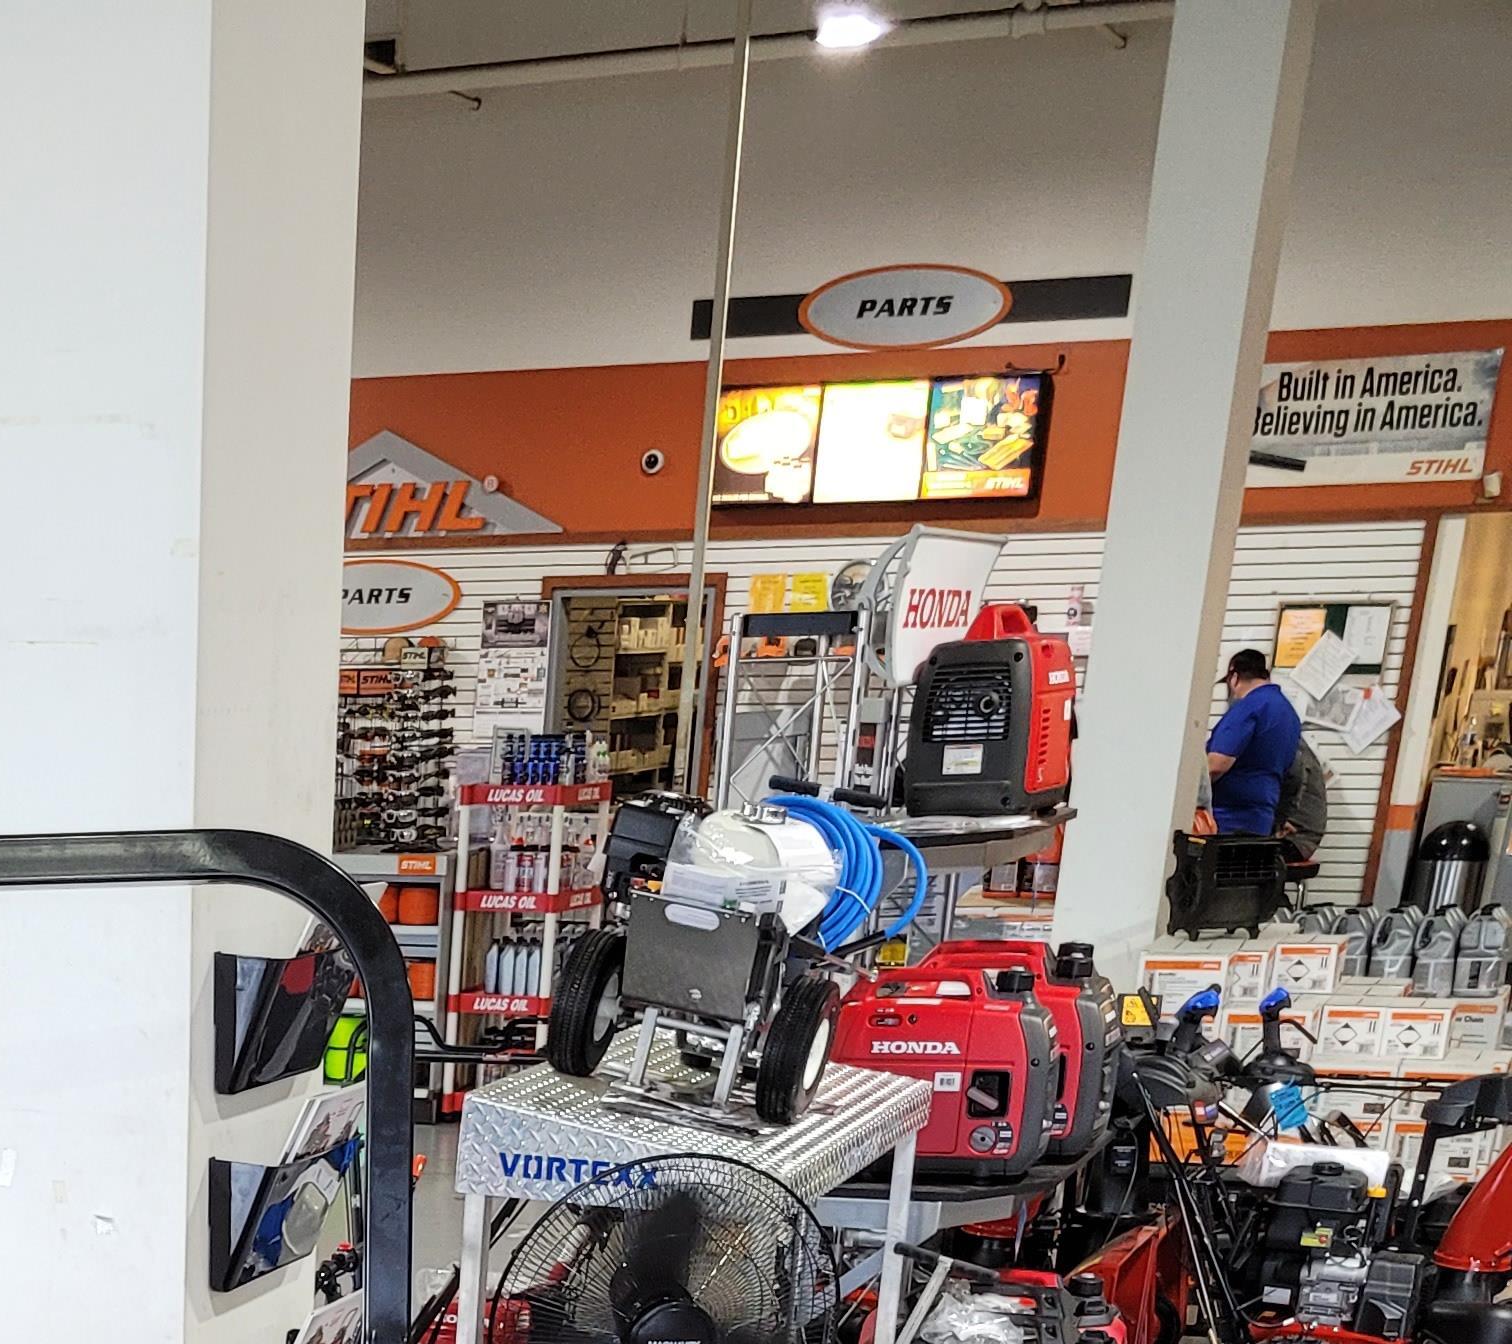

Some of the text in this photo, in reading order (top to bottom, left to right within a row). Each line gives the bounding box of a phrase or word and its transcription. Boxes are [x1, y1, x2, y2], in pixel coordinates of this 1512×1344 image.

[856, 295, 954, 319] PARTS
[1277, 363, 1463, 402] Built in America.
[1353, 401, 1376, 432] in
[1380, 396, 1483, 431] America.
[1406, 458, 1473, 475] STIHL
[984, 476, 1023, 489] STIHL
[346, 480, 486, 533] TIHL
[902, 588, 972, 629] HONDA
[402, 651, 426, 661] STIHL
[487, 789, 545, 802] LUCAS OIL
[400, 859, 433, 870] STIHL
[480, 895, 537, 909] LUCAS OIL
[473, 997, 529, 1011] LUCAS OIL
[871, 1041, 961, 1055] HONDA
